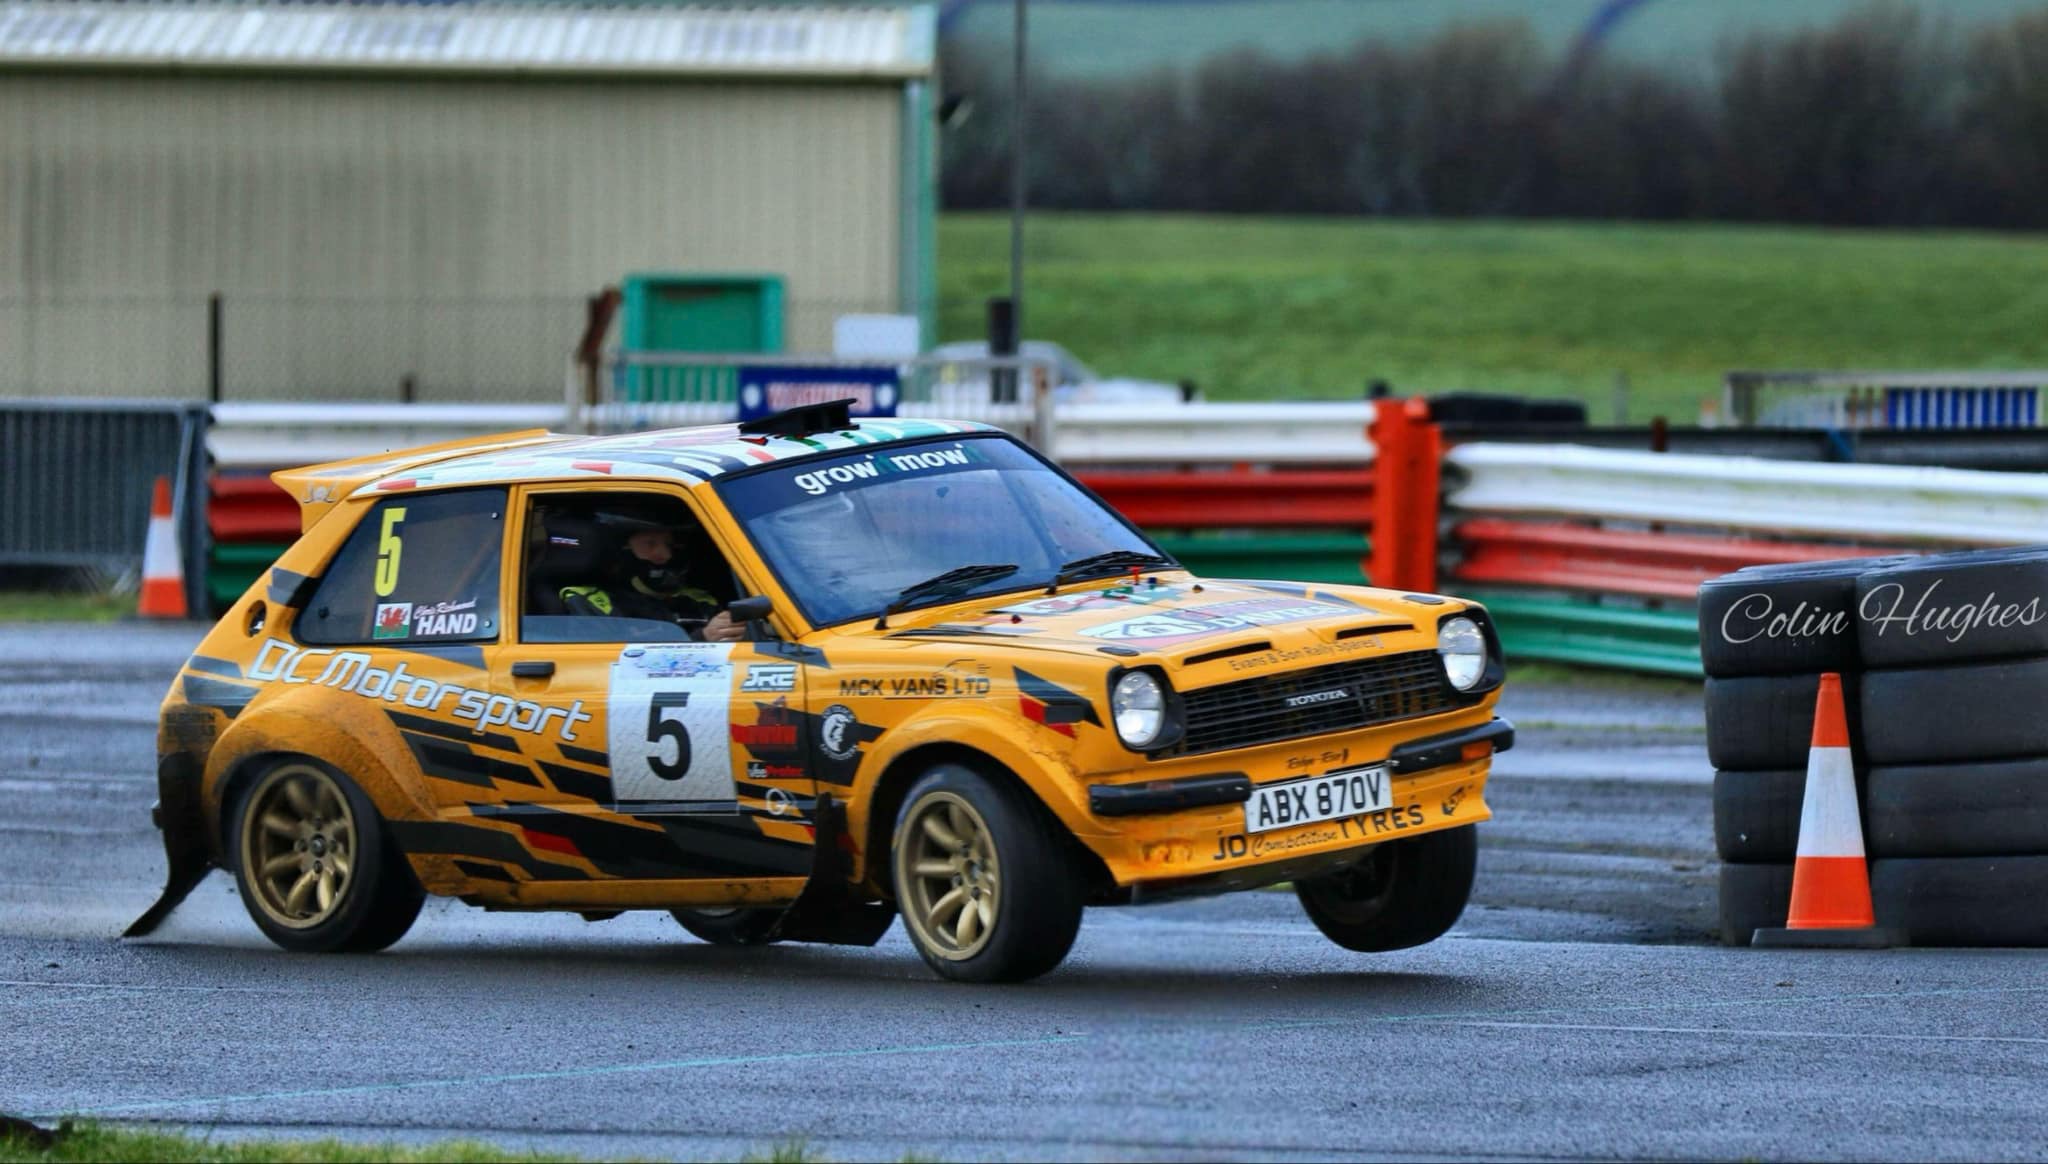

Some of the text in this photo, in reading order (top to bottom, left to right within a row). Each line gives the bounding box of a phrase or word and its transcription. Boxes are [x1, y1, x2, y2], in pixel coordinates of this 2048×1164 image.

[374, 506, 408, 597] 5
[416, 613, 478, 635] HAND
[839, 677, 990, 696] MCK VANS LTD
[1228, 655, 1265, 672] Evans
[1279, 649, 1302, 662] Son
[1303, 645, 1335, 658] Rally
[247, 638, 592, 741] DC Motorsport
[1286, 689, 1349, 706] TOYOTA
[646, 691, 692, 780] 5
[1258, 771, 1382, 827] ABX 870V
[1213, 804, 1425, 860] JD Competition TYRES
